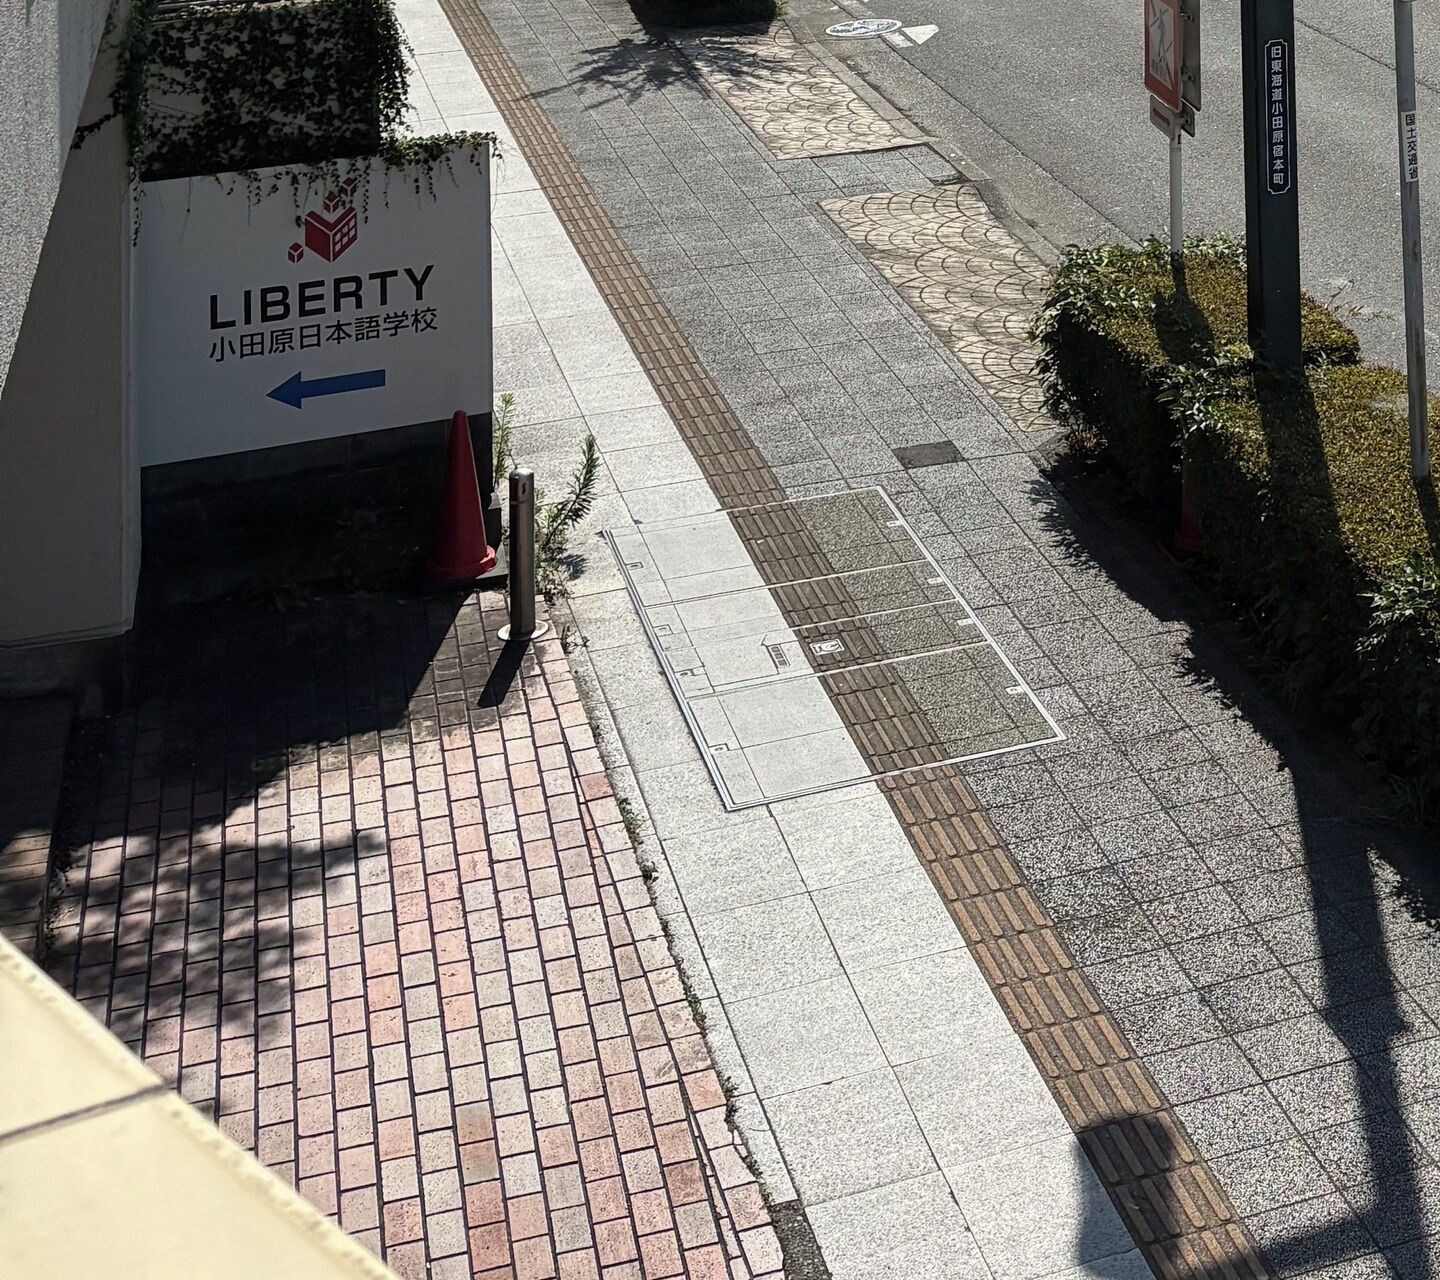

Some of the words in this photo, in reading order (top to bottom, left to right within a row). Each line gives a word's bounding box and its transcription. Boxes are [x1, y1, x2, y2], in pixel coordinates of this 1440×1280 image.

[1270, 45, 1285, 186] 旧東海道小田原宿本町
[1405, 113, 1419, 180] 国土交通省
[208, 264, 435, 331] LIBERTY
[208, 306, 438, 363] 小田原日本語学校
